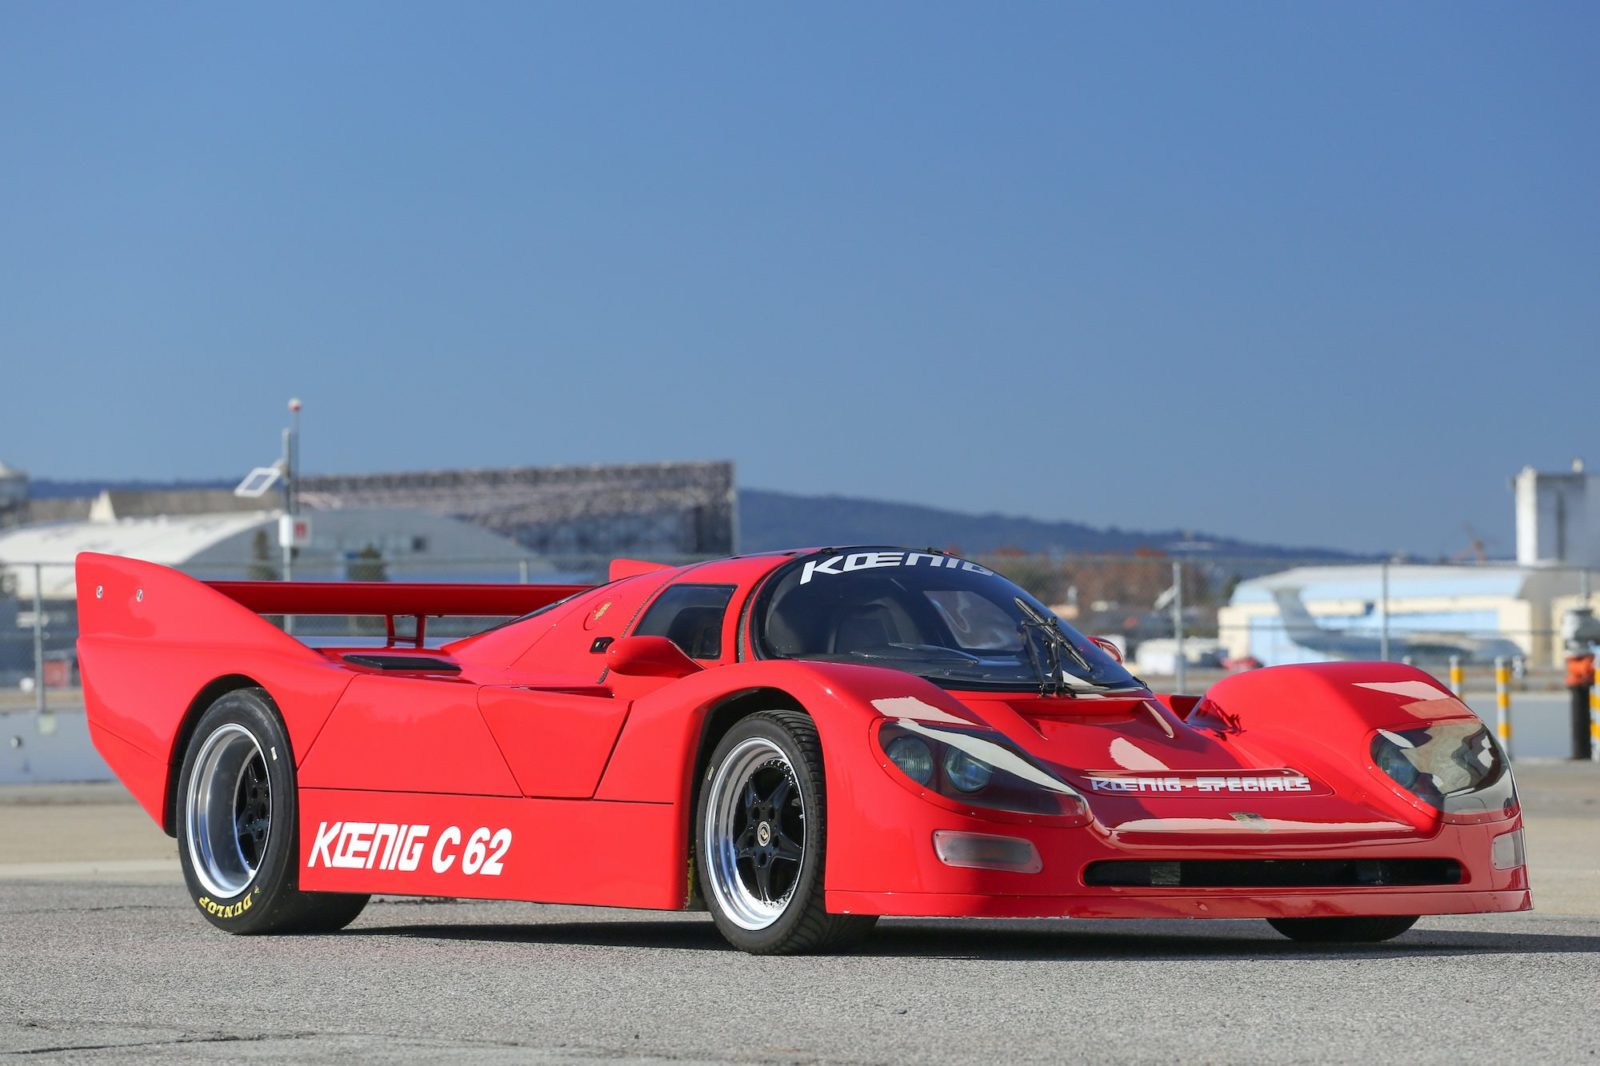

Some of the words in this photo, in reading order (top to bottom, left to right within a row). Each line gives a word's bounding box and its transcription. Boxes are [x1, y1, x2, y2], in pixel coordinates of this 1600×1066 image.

[432, 826, 461, 873] C
[462, 827, 513, 876] 62
[198, 892, 253, 918] DUNLOP
